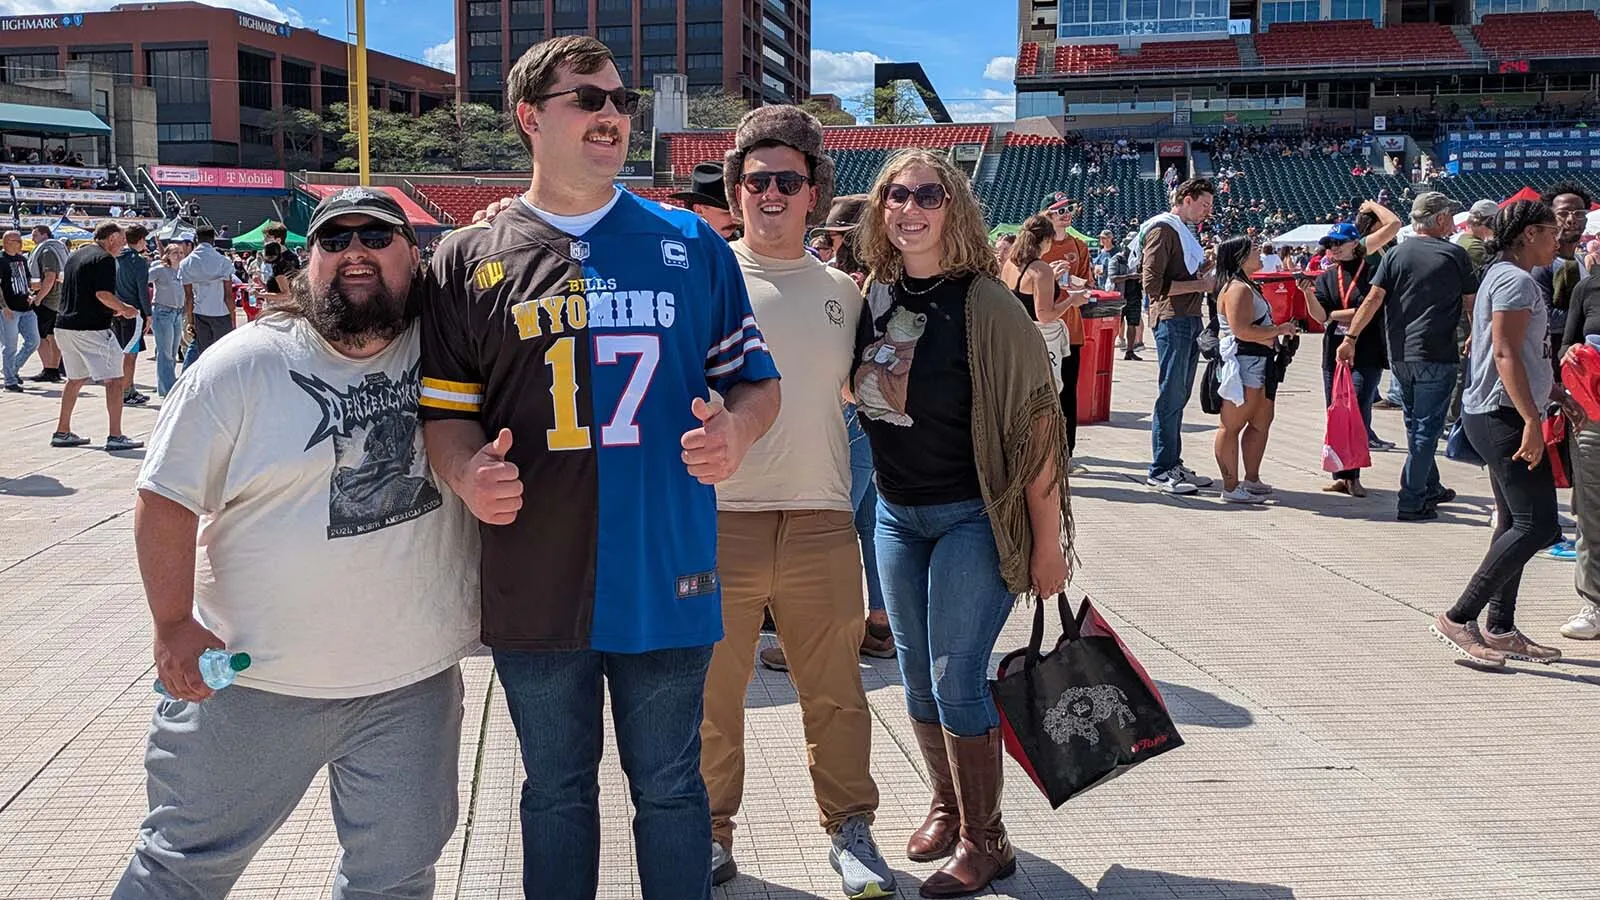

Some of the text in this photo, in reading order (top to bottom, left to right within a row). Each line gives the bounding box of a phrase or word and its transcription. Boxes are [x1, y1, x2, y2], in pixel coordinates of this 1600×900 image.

[1563, 149, 1582, 157] Zone
[664, 242, 686, 262] C
[569, 278, 617, 294] BILLS
[511, 291, 675, 340] WYOMING
[544, 334, 661, 451] 17
